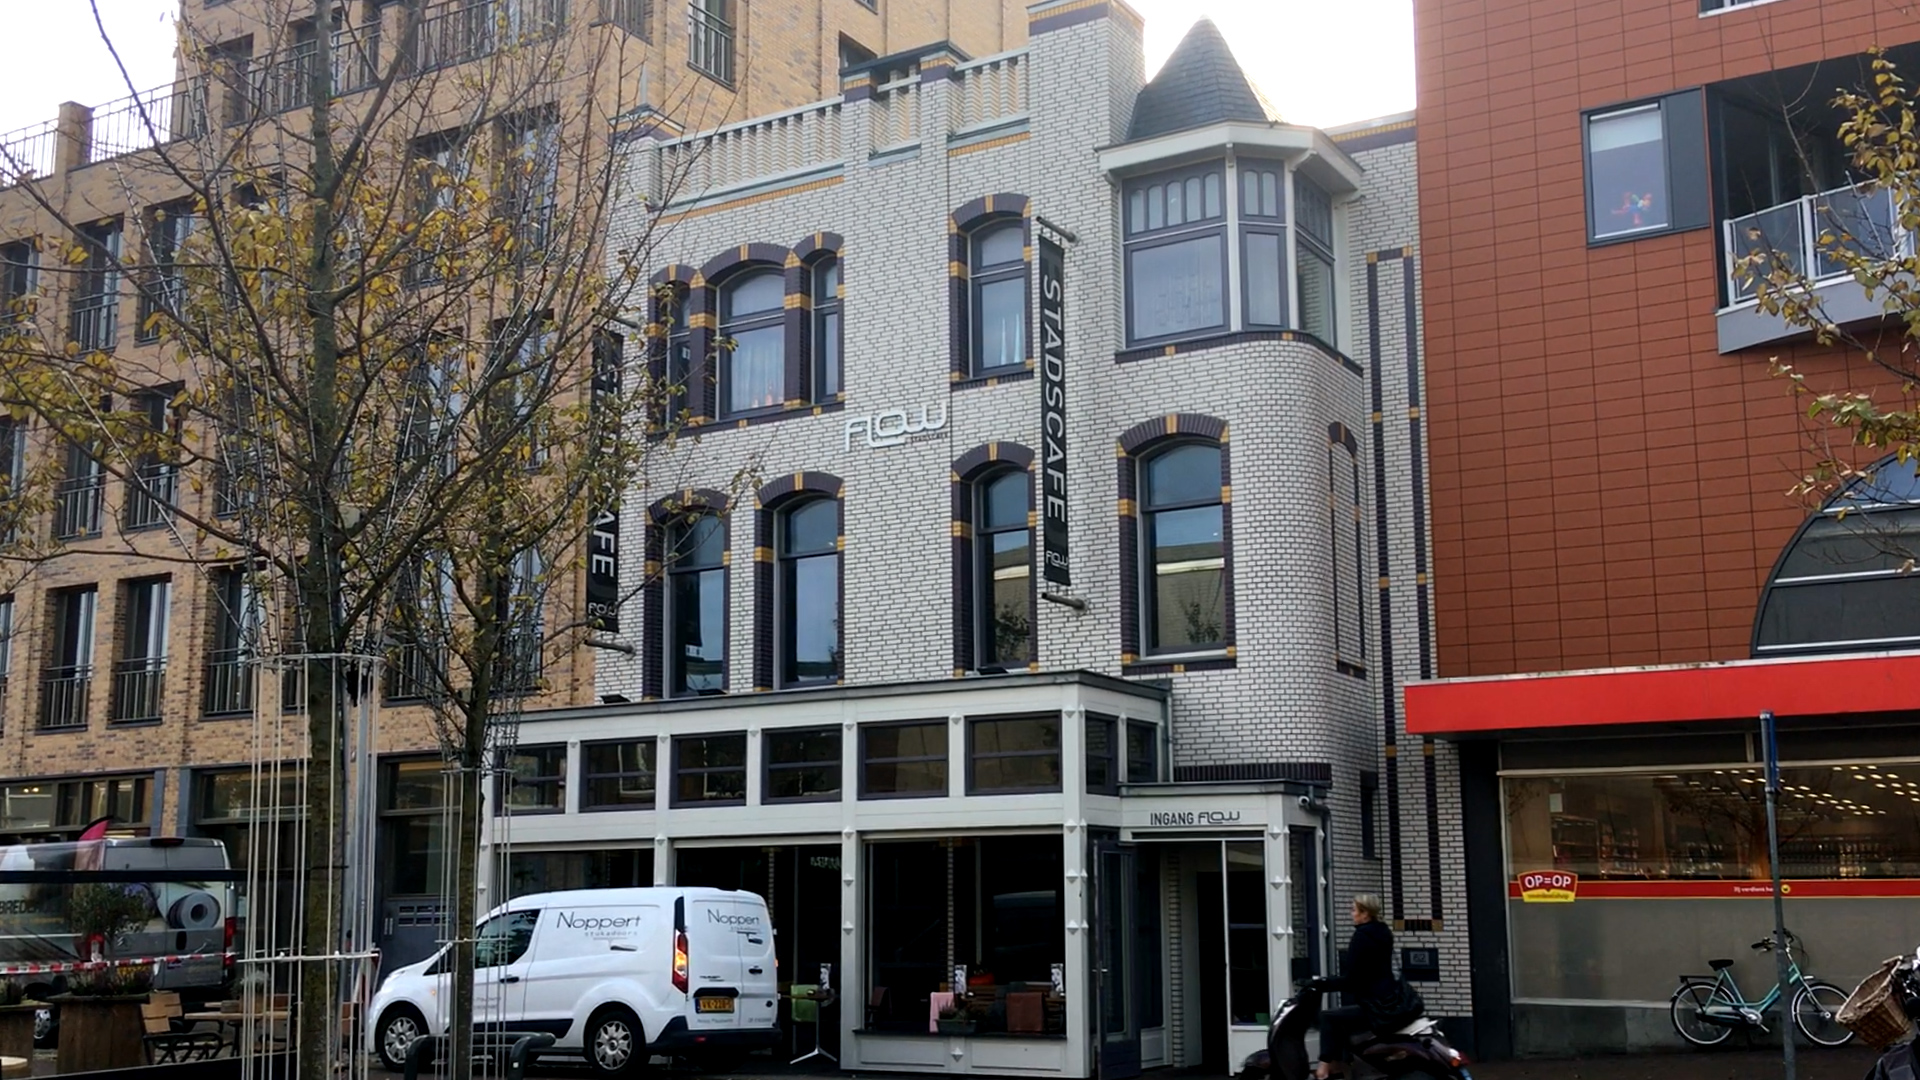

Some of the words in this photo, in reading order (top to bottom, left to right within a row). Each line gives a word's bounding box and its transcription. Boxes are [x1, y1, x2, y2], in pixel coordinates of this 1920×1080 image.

[1043, 274, 1066, 523] STADSCAFE
[1150, 811, 1194, 826] INGANG
[1524, 874, 1571, 888] OP=OP
[556, 911, 641, 931] Noppert
